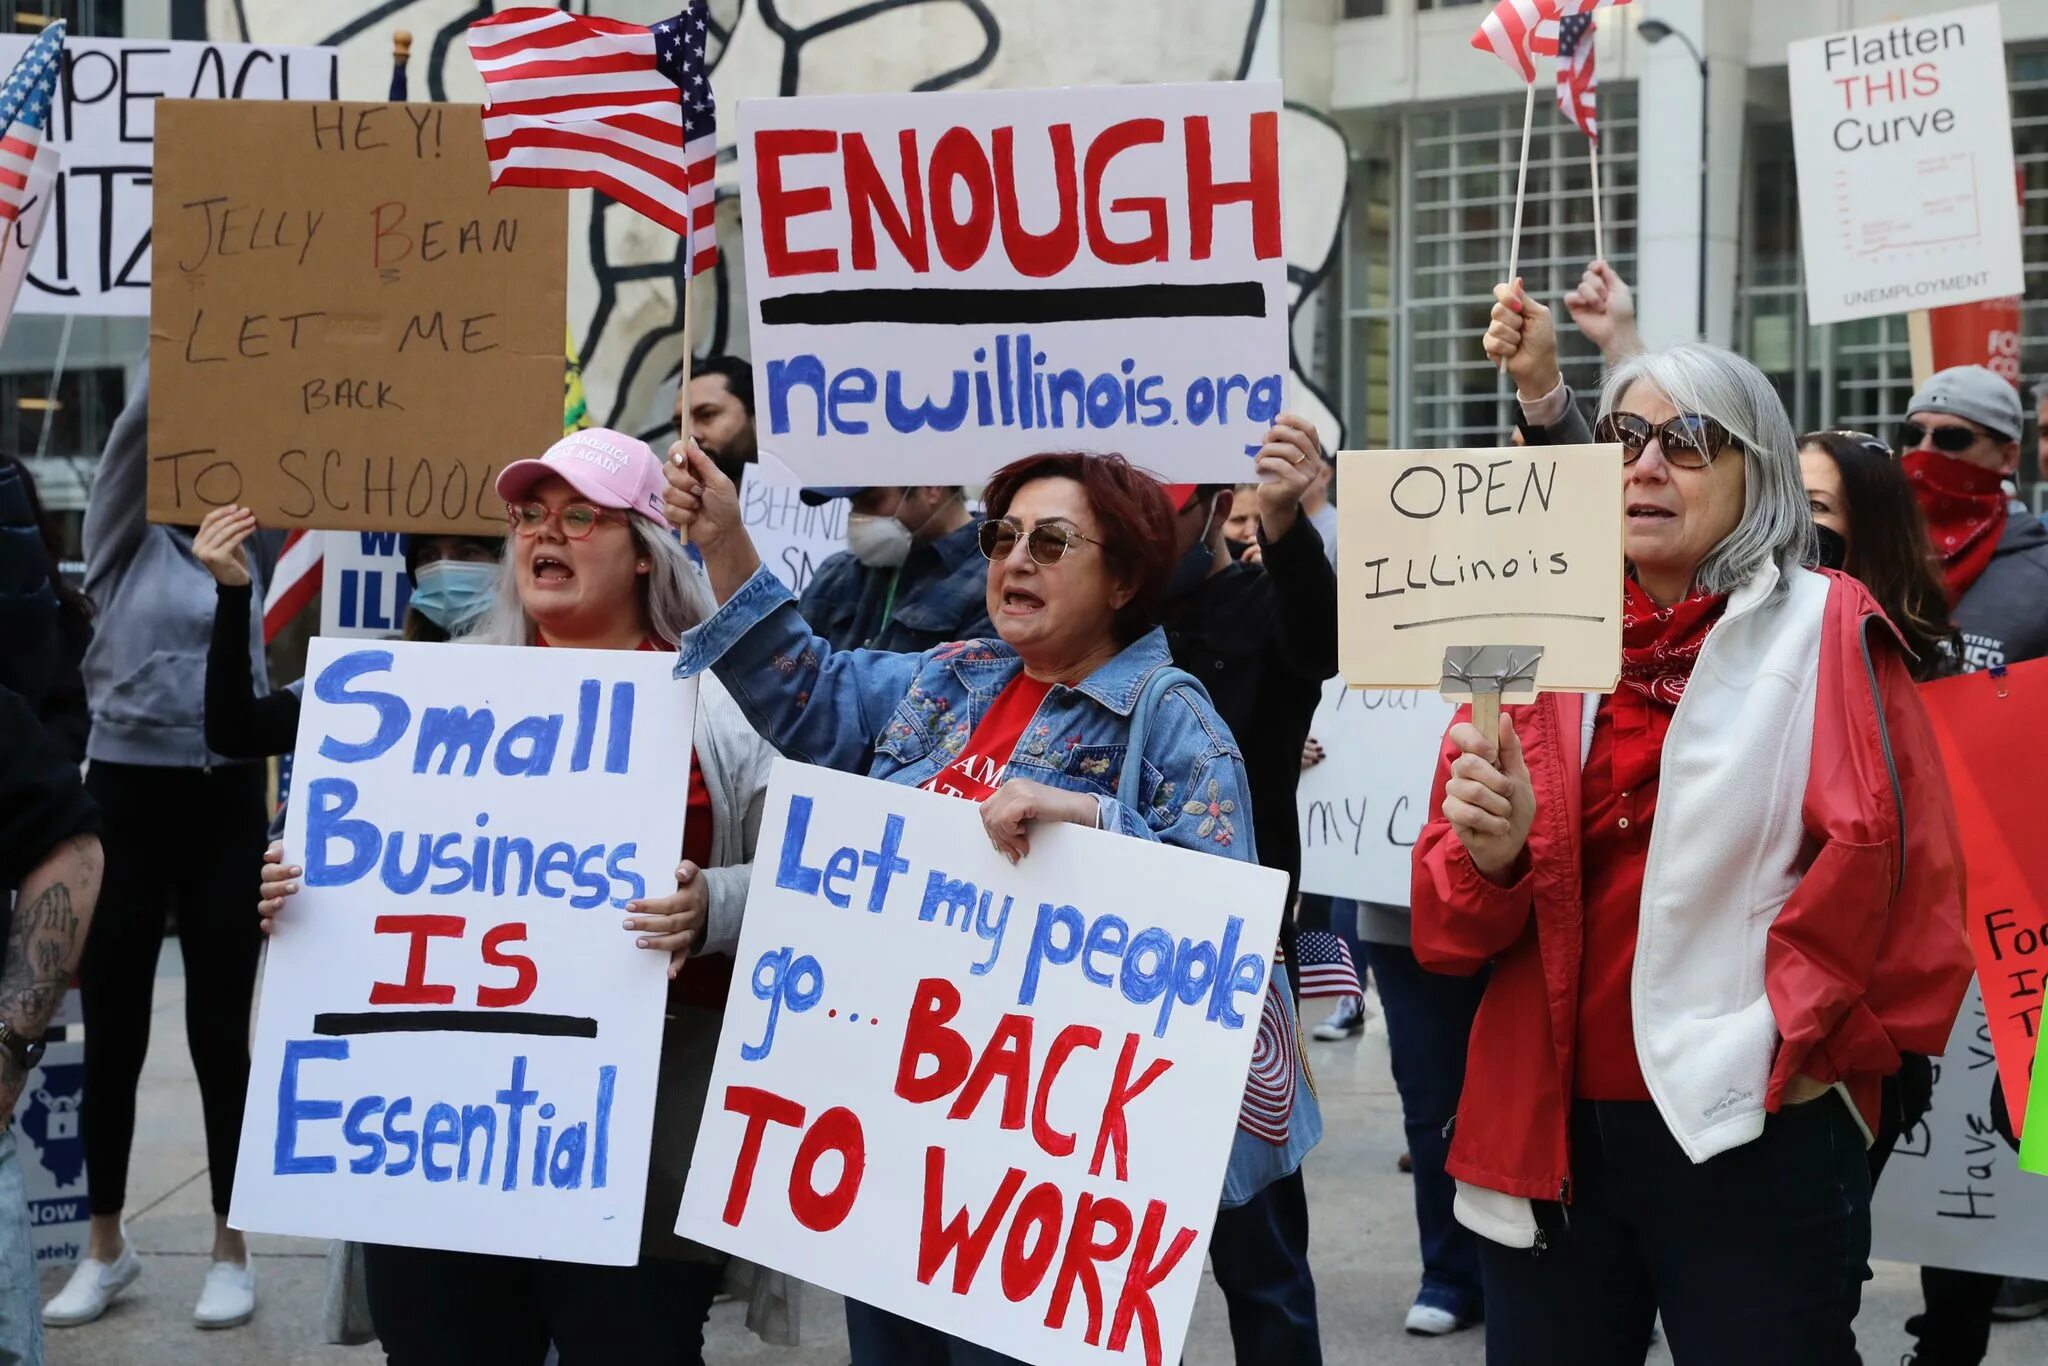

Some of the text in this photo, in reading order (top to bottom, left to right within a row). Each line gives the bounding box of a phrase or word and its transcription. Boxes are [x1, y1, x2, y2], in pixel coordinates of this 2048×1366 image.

[1824, 21, 1965, 72] Flatten
[1834, 62, 1940, 110] THIS
[312, 105, 443, 158] HEY!
[1834, 107, 1955, 151] Curve
[754, 111, 1282, 278] ENOUGH
[179, 196, 517, 273] JELLY BEAN
[1843, 271, 1991, 307] UNEMPLOYMENT
[186, 309, 500, 363] LET ME
[302, 378, 405, 414] BACK
[766, 332, 1283, 457] newillinois.org
[154, 449, 510, 524] TO SCHOOL
[575, 448, 620, 475] AGAIN
[1390, 460, 1557, 519] OPEN
[1961, 633, 2001, 649] CTION
[314, 650, 636, 777] Small
[304, 777, 645, 909] Business
[1387, 795, 1417, 847] C
[775, 794, 1266, 1038] Let my people
[369, 914, 539, 1009] IS
[894, 978, 1174, 1182] BACK
[274, 1039, 617, 1191] Essential
[36, 1241, 80, 1261] ately
[722, 1085, 1199, 1366] TO WORK
